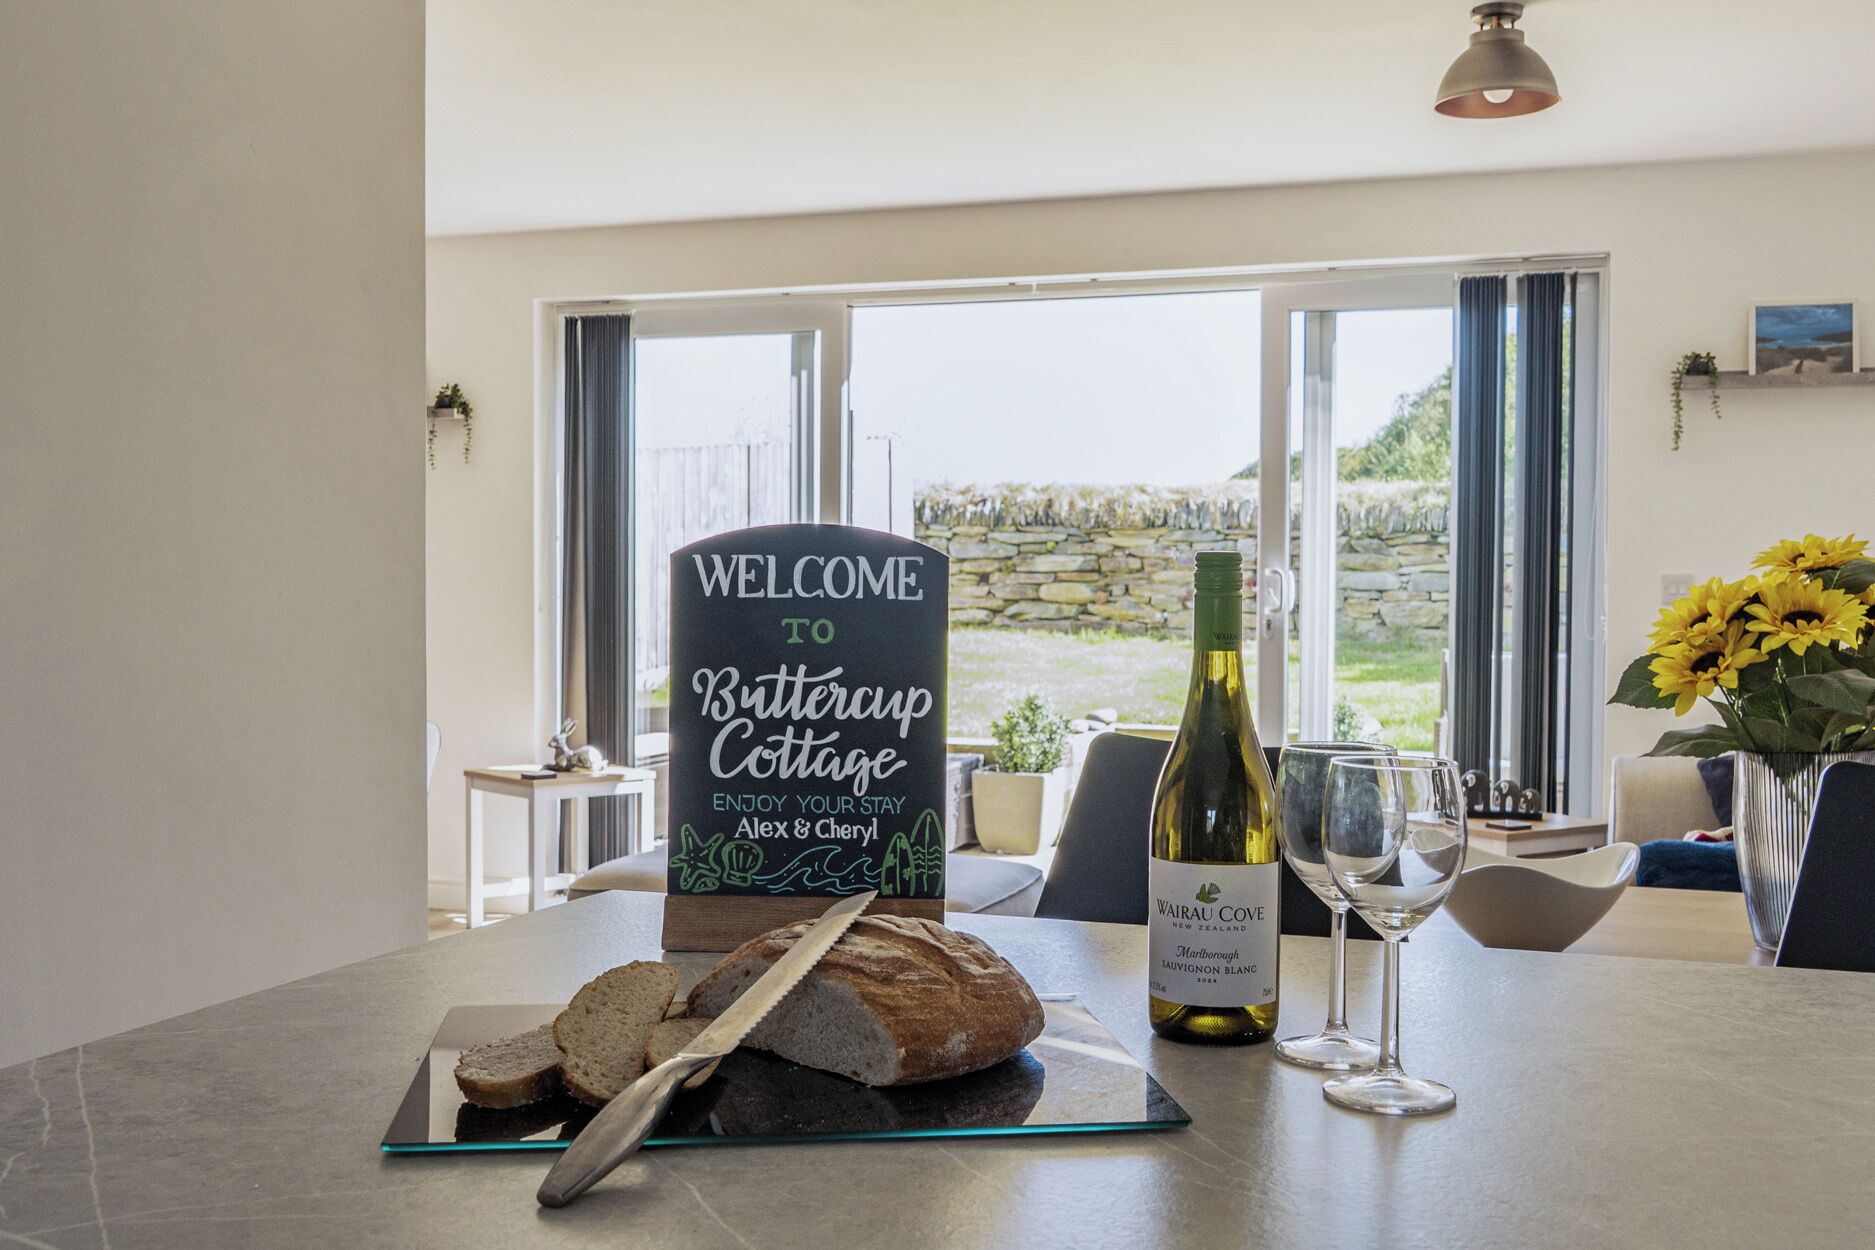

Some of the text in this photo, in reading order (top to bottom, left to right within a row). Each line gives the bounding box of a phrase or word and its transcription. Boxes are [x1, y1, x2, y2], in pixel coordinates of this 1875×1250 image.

[692, 554, 924, 600] WELCOME
[781, 618, 836, 645] TO
[692, 663, 933, 739] Buttercup
[709, 717, 908, 797] Cottage
[713, 793, 906, 815] ENJOY YOUR STAY
[733, 816, 879, 847] Alex & Cheryl
[1156, 898, 1265, 923] WAIRAU COVE
[1172, 921, 1247, 932] NEW ZEALAND
[1175, 945, 1240, 964] Marlborough
[1161, 960, 1258, 976] SAUVIGNON BLANC
